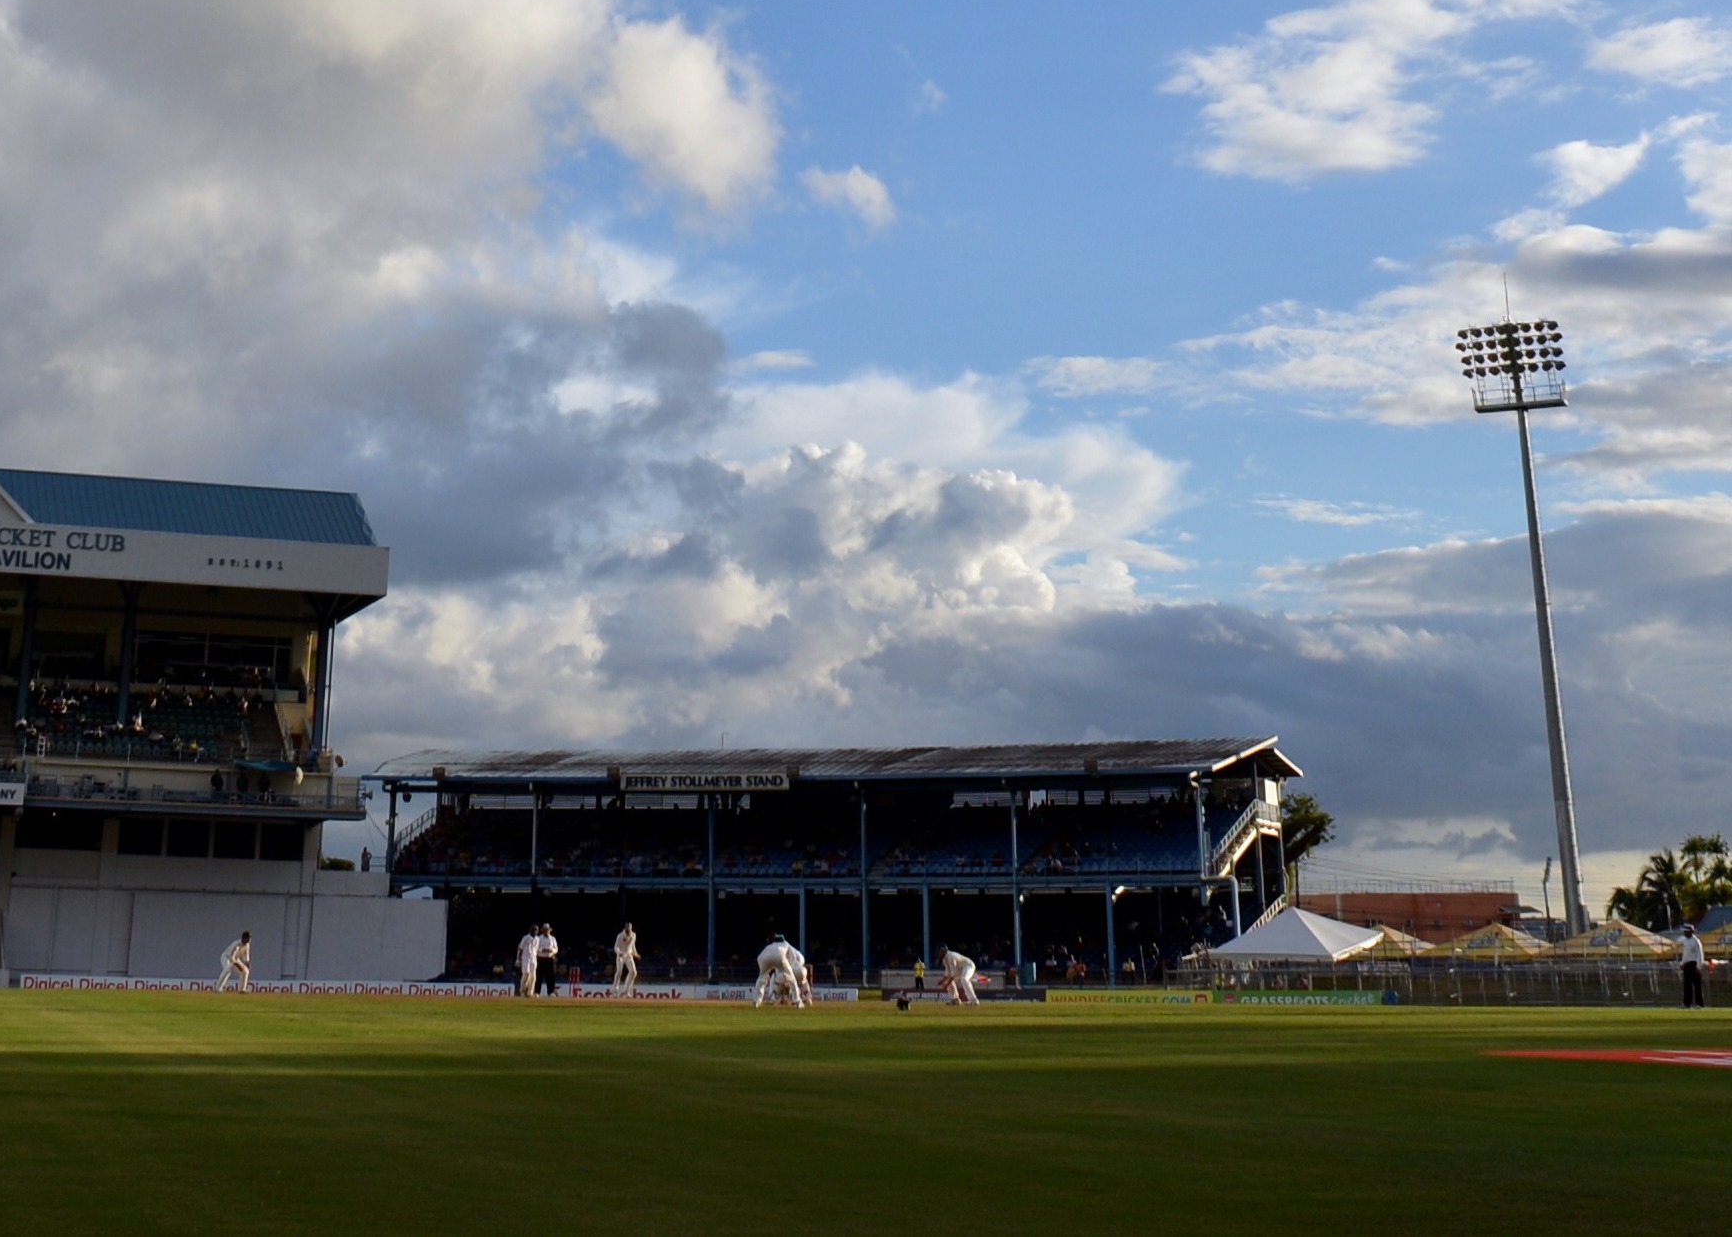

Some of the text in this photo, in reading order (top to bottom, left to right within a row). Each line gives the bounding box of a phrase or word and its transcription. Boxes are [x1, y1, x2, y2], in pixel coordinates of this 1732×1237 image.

[66, 531, 125, 552] CLUB
[625, 775, 783, 788] JEFFREY STOLLMEYER STAND
